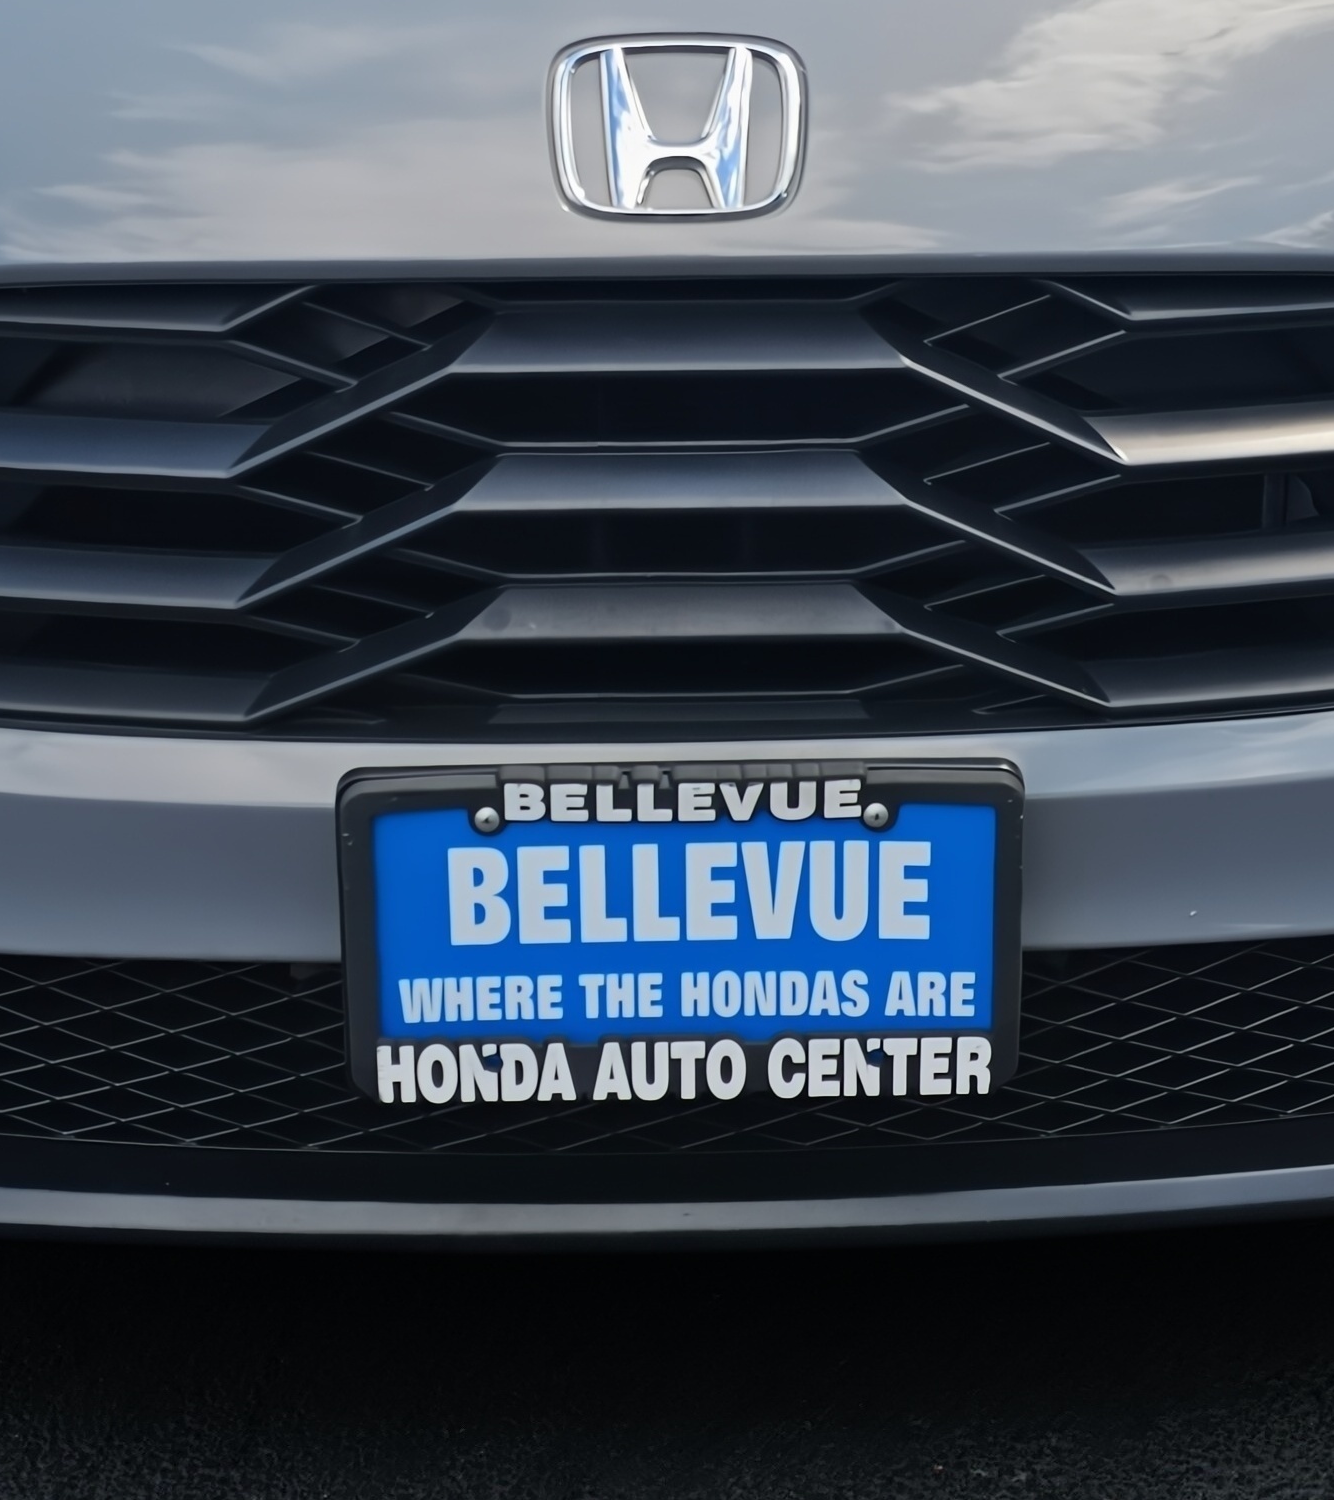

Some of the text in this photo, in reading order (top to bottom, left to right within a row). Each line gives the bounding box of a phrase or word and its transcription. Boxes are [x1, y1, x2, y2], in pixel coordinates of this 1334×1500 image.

[503, 778, 863, 822] BELLEVUE
[447, 840, 932, 946] BELLEVUE
[398, 969, 976, 1024] WHERE THE HONDAS ARE
[376, 1036, 993, 1104] HONDA AUTO CENTER
